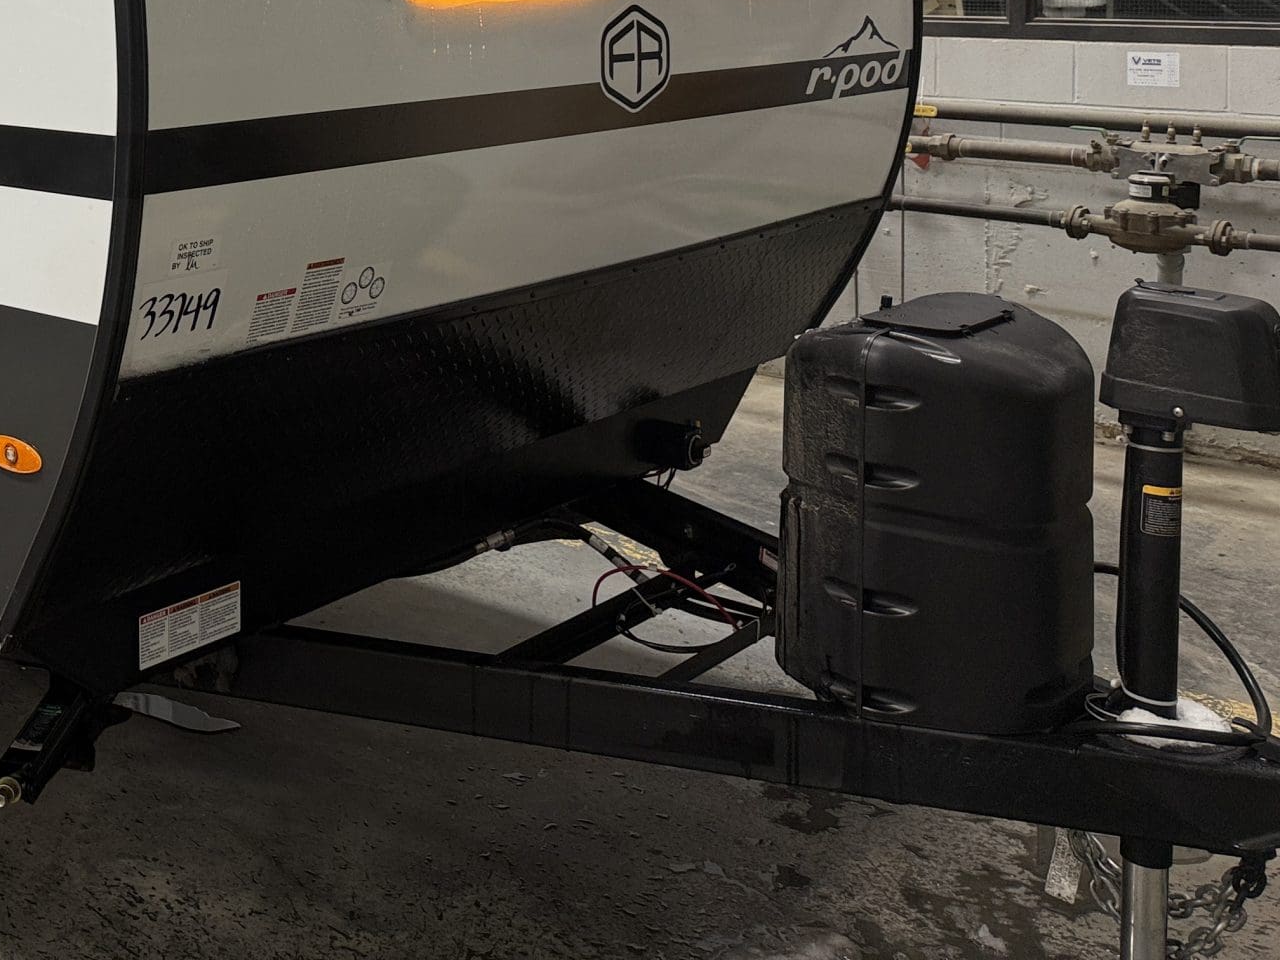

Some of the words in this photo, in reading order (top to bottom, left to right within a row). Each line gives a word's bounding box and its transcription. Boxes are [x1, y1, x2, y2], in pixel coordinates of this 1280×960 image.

[178, 242, 188, 251] OK
[189, 241, 199, 249] TO
[199, 238, 214, 248] SHIP
[177, 247, 212, 260] INSPECTED
[171, 262, 181, 270] BY
[139, 287, 221, 340] 33749
